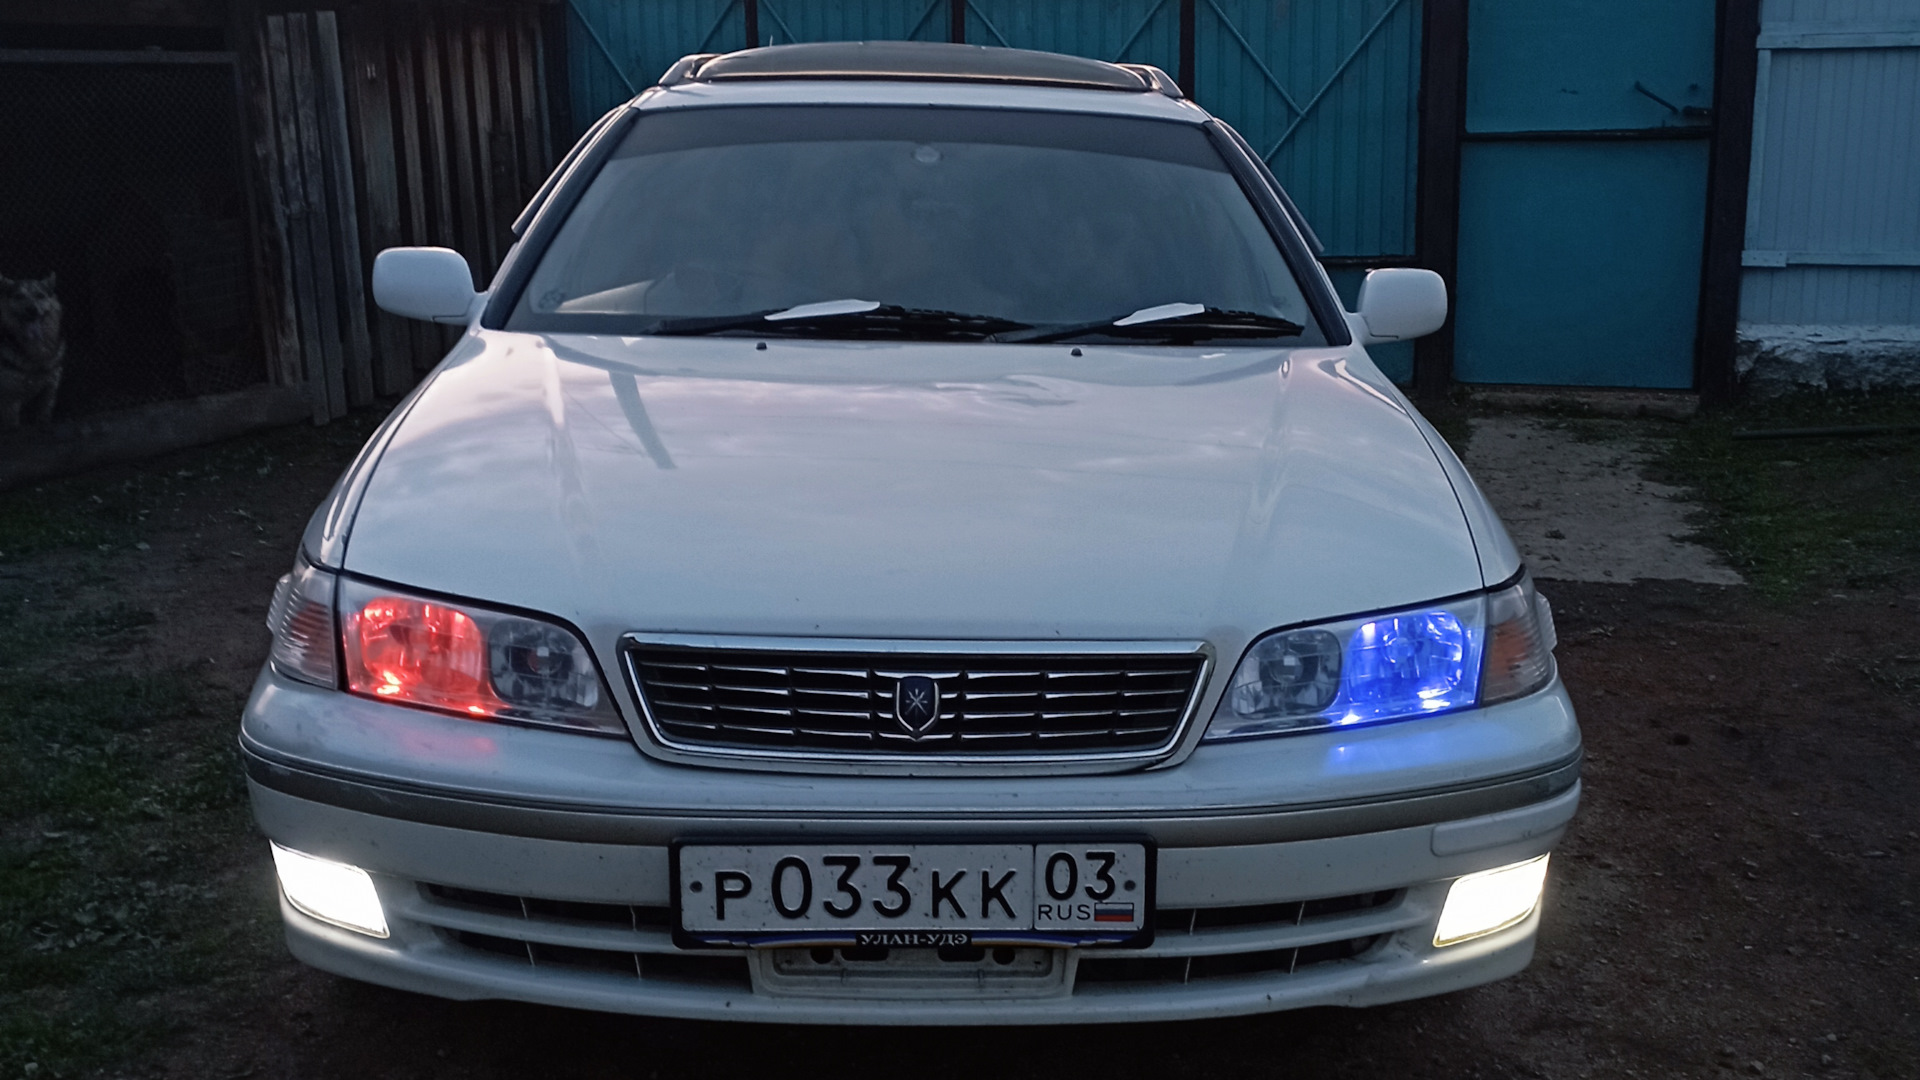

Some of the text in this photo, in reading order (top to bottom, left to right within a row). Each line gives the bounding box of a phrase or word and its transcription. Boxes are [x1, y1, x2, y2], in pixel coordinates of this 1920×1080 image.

[1045, 851, 1116, 902] 03
[1037, 904, 1091, 921] RUS
[860, 933, 968, 947] УЛАН-УДЭ
